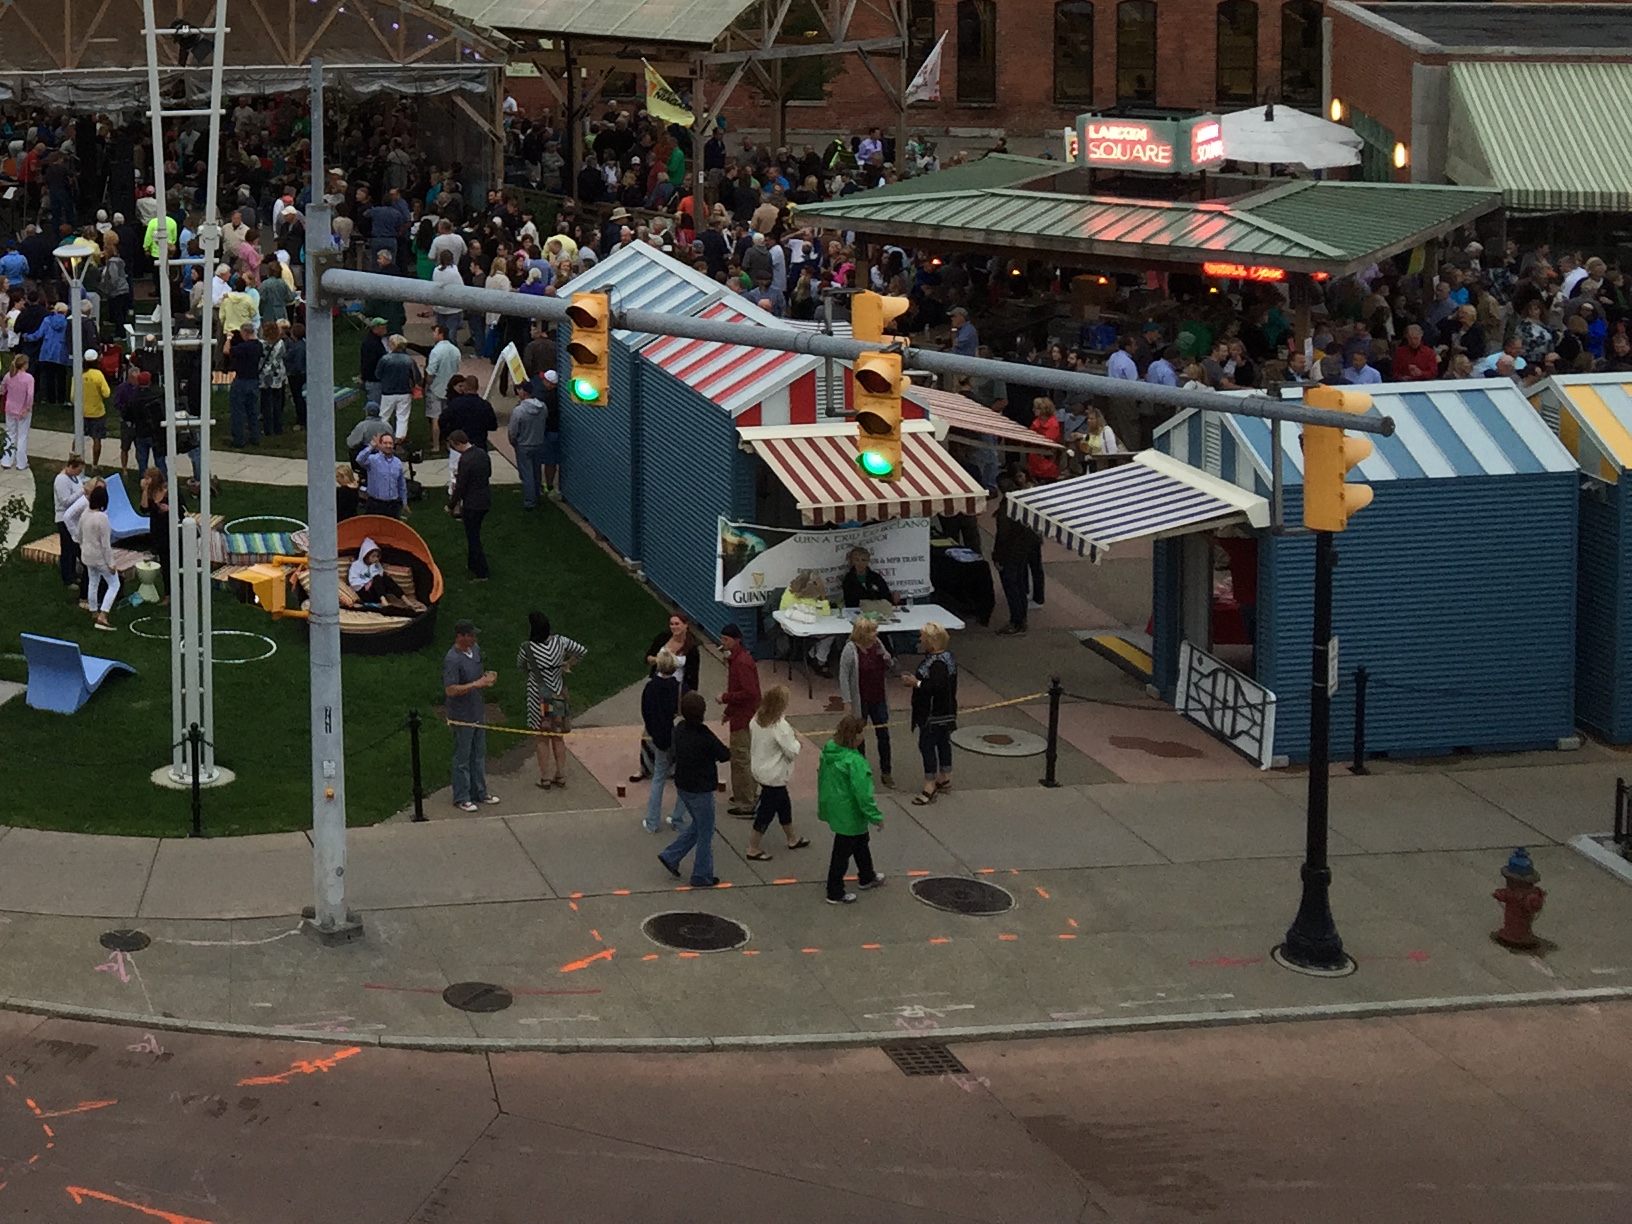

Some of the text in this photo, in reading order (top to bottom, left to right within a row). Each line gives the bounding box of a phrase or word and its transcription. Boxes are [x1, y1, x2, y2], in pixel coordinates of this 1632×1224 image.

[1088, 125, 1148, 141] LARKIN
[1089, 142, 1172, 163] SQUARE
[793, 535, 819, 544] WIN
[834, 533, 860, 543] TRIP
[902, 555, 926, 563] TRAVEL
